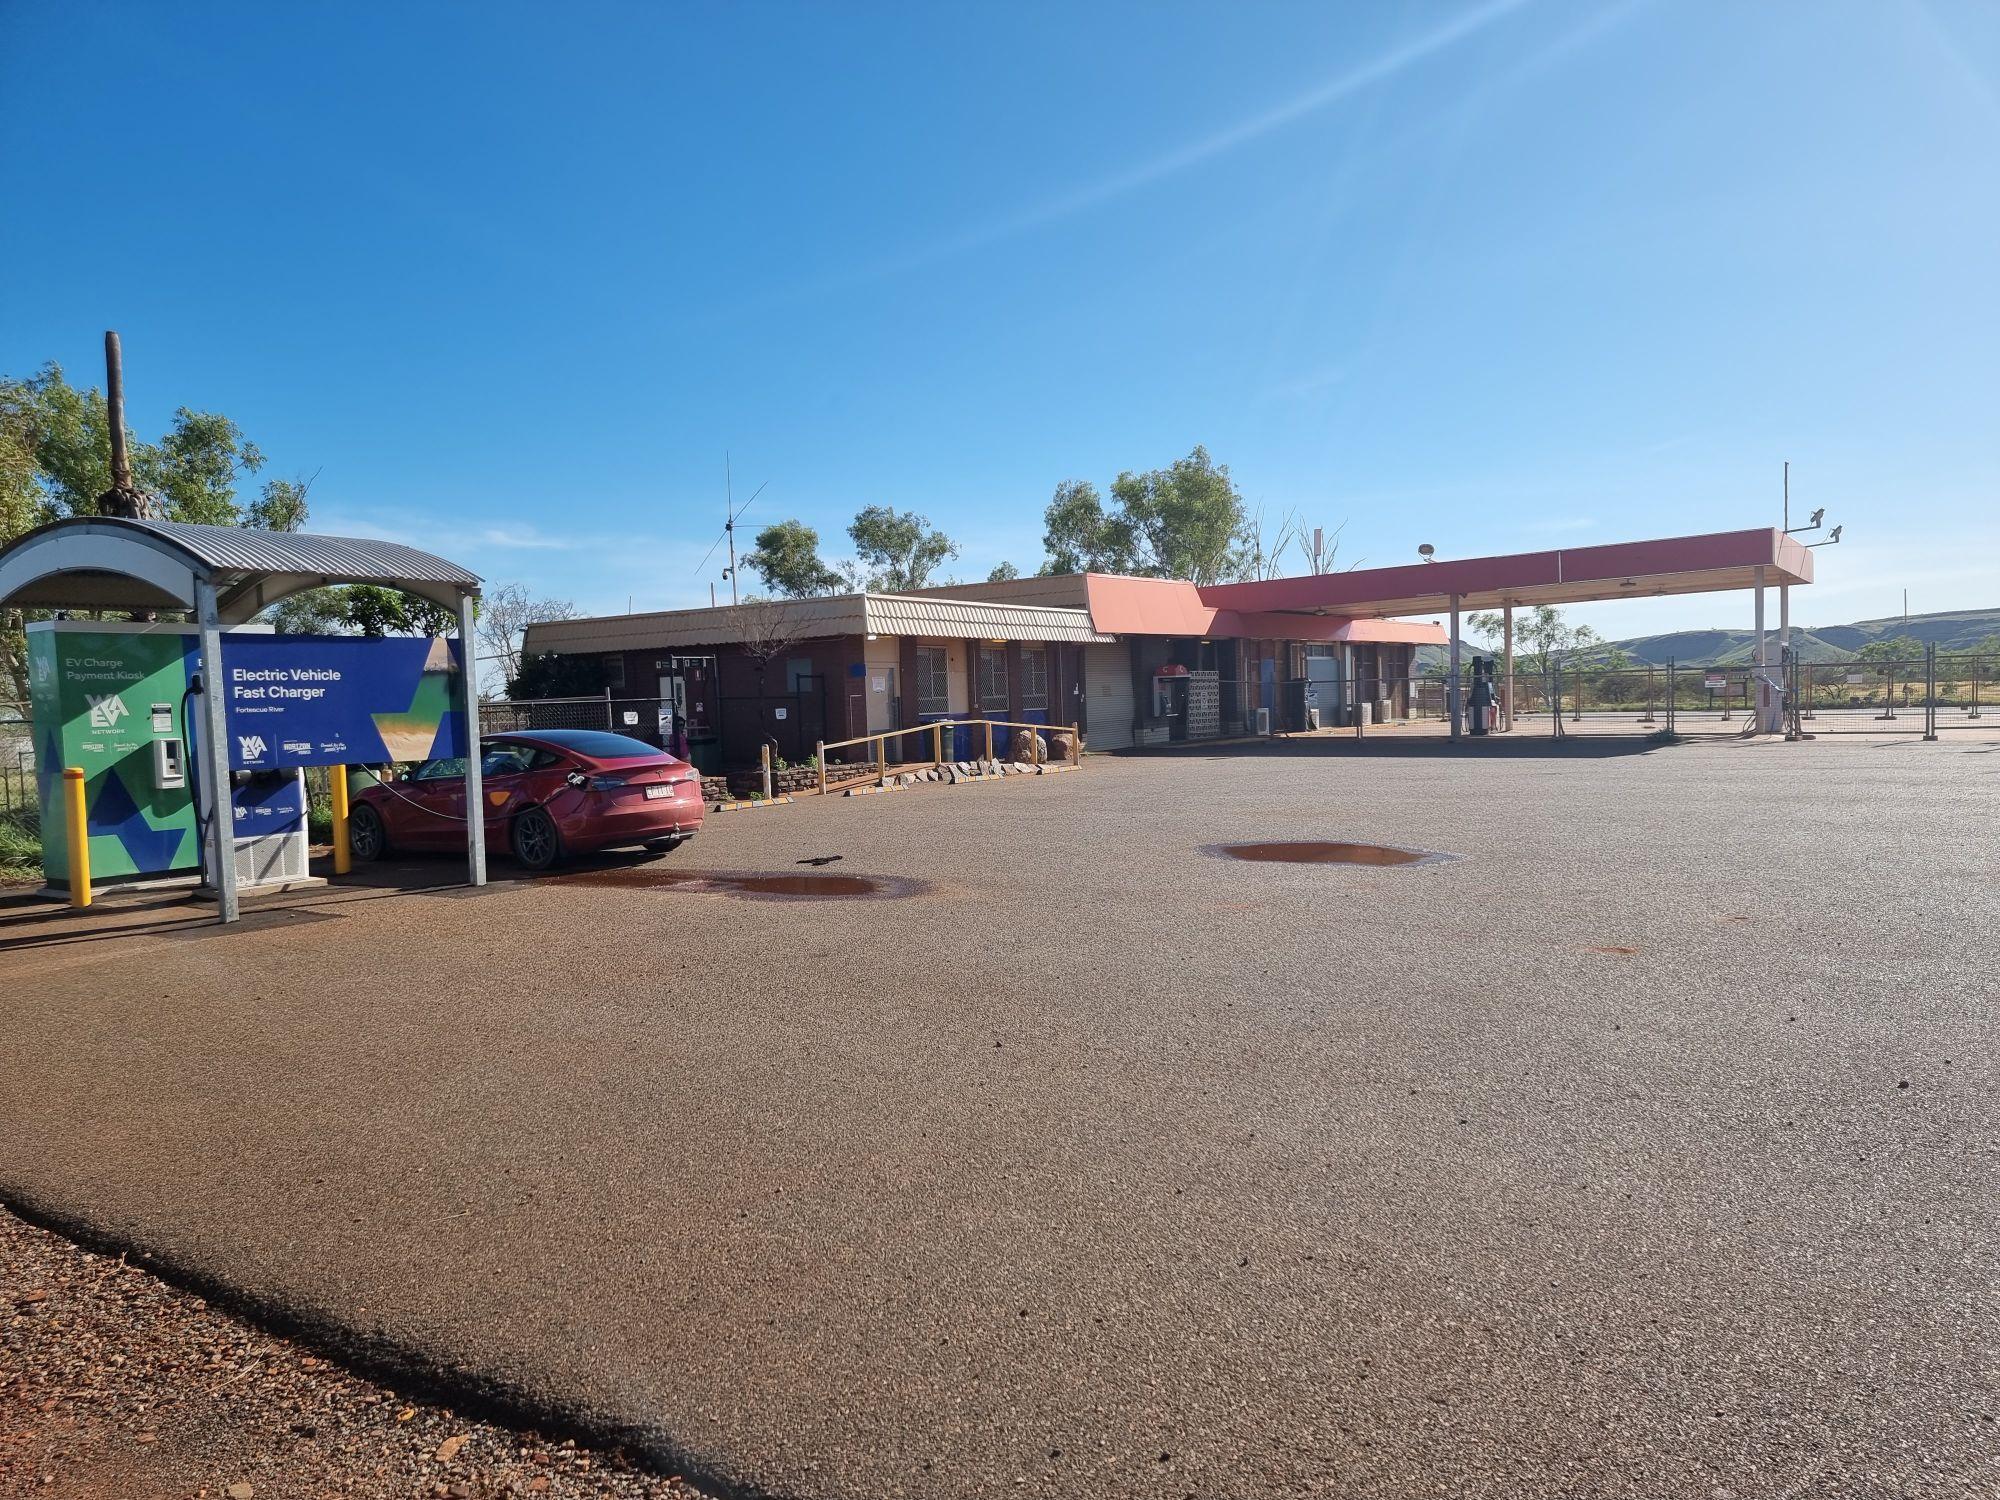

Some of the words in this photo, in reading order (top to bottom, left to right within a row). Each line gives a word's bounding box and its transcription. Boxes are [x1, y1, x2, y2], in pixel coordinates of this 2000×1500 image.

[65, 658, 82, 667] EV
[83, 658, 124, 669] Charge
[67, 672, 115, 682] Payment
[117, 672, 145, 680] Kiosk
[233, 669, 289, 681] Electric
[290, 669, 341, 681] Vehicle
[234, 686, 266, 698] Fast
[268, 686, 326, 700] Charger
